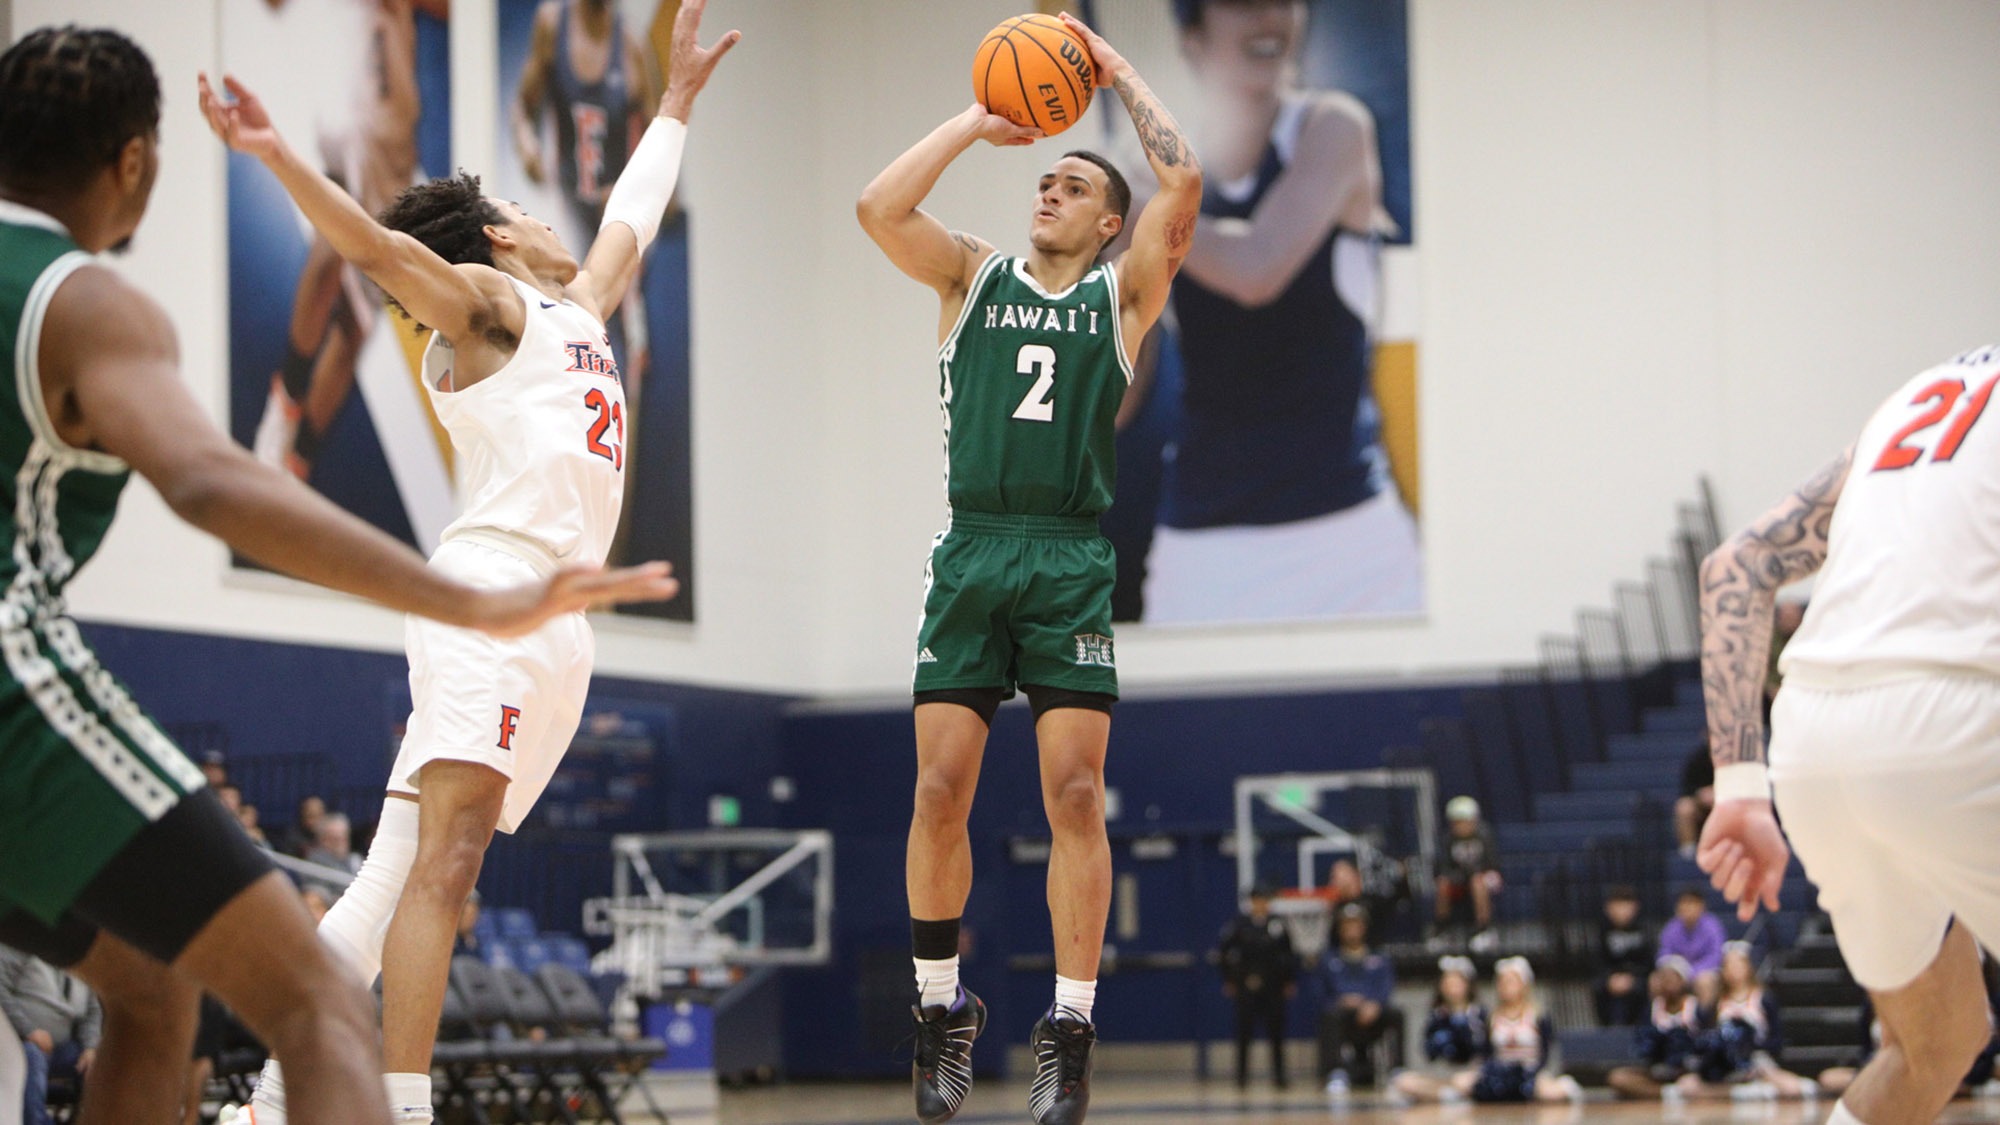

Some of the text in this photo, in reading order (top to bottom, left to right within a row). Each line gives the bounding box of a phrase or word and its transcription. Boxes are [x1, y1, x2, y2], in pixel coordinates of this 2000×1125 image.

[1060, 39, 1092, 101] Wilso
[1038, 83, 1066, 122] EVO
[984, 303, 1098, 335] HAWAI'I
[1011, 344, 1056, 422] 2
[1869, 370, 2000, 474] 21
[496, 704, 521, 751] F
